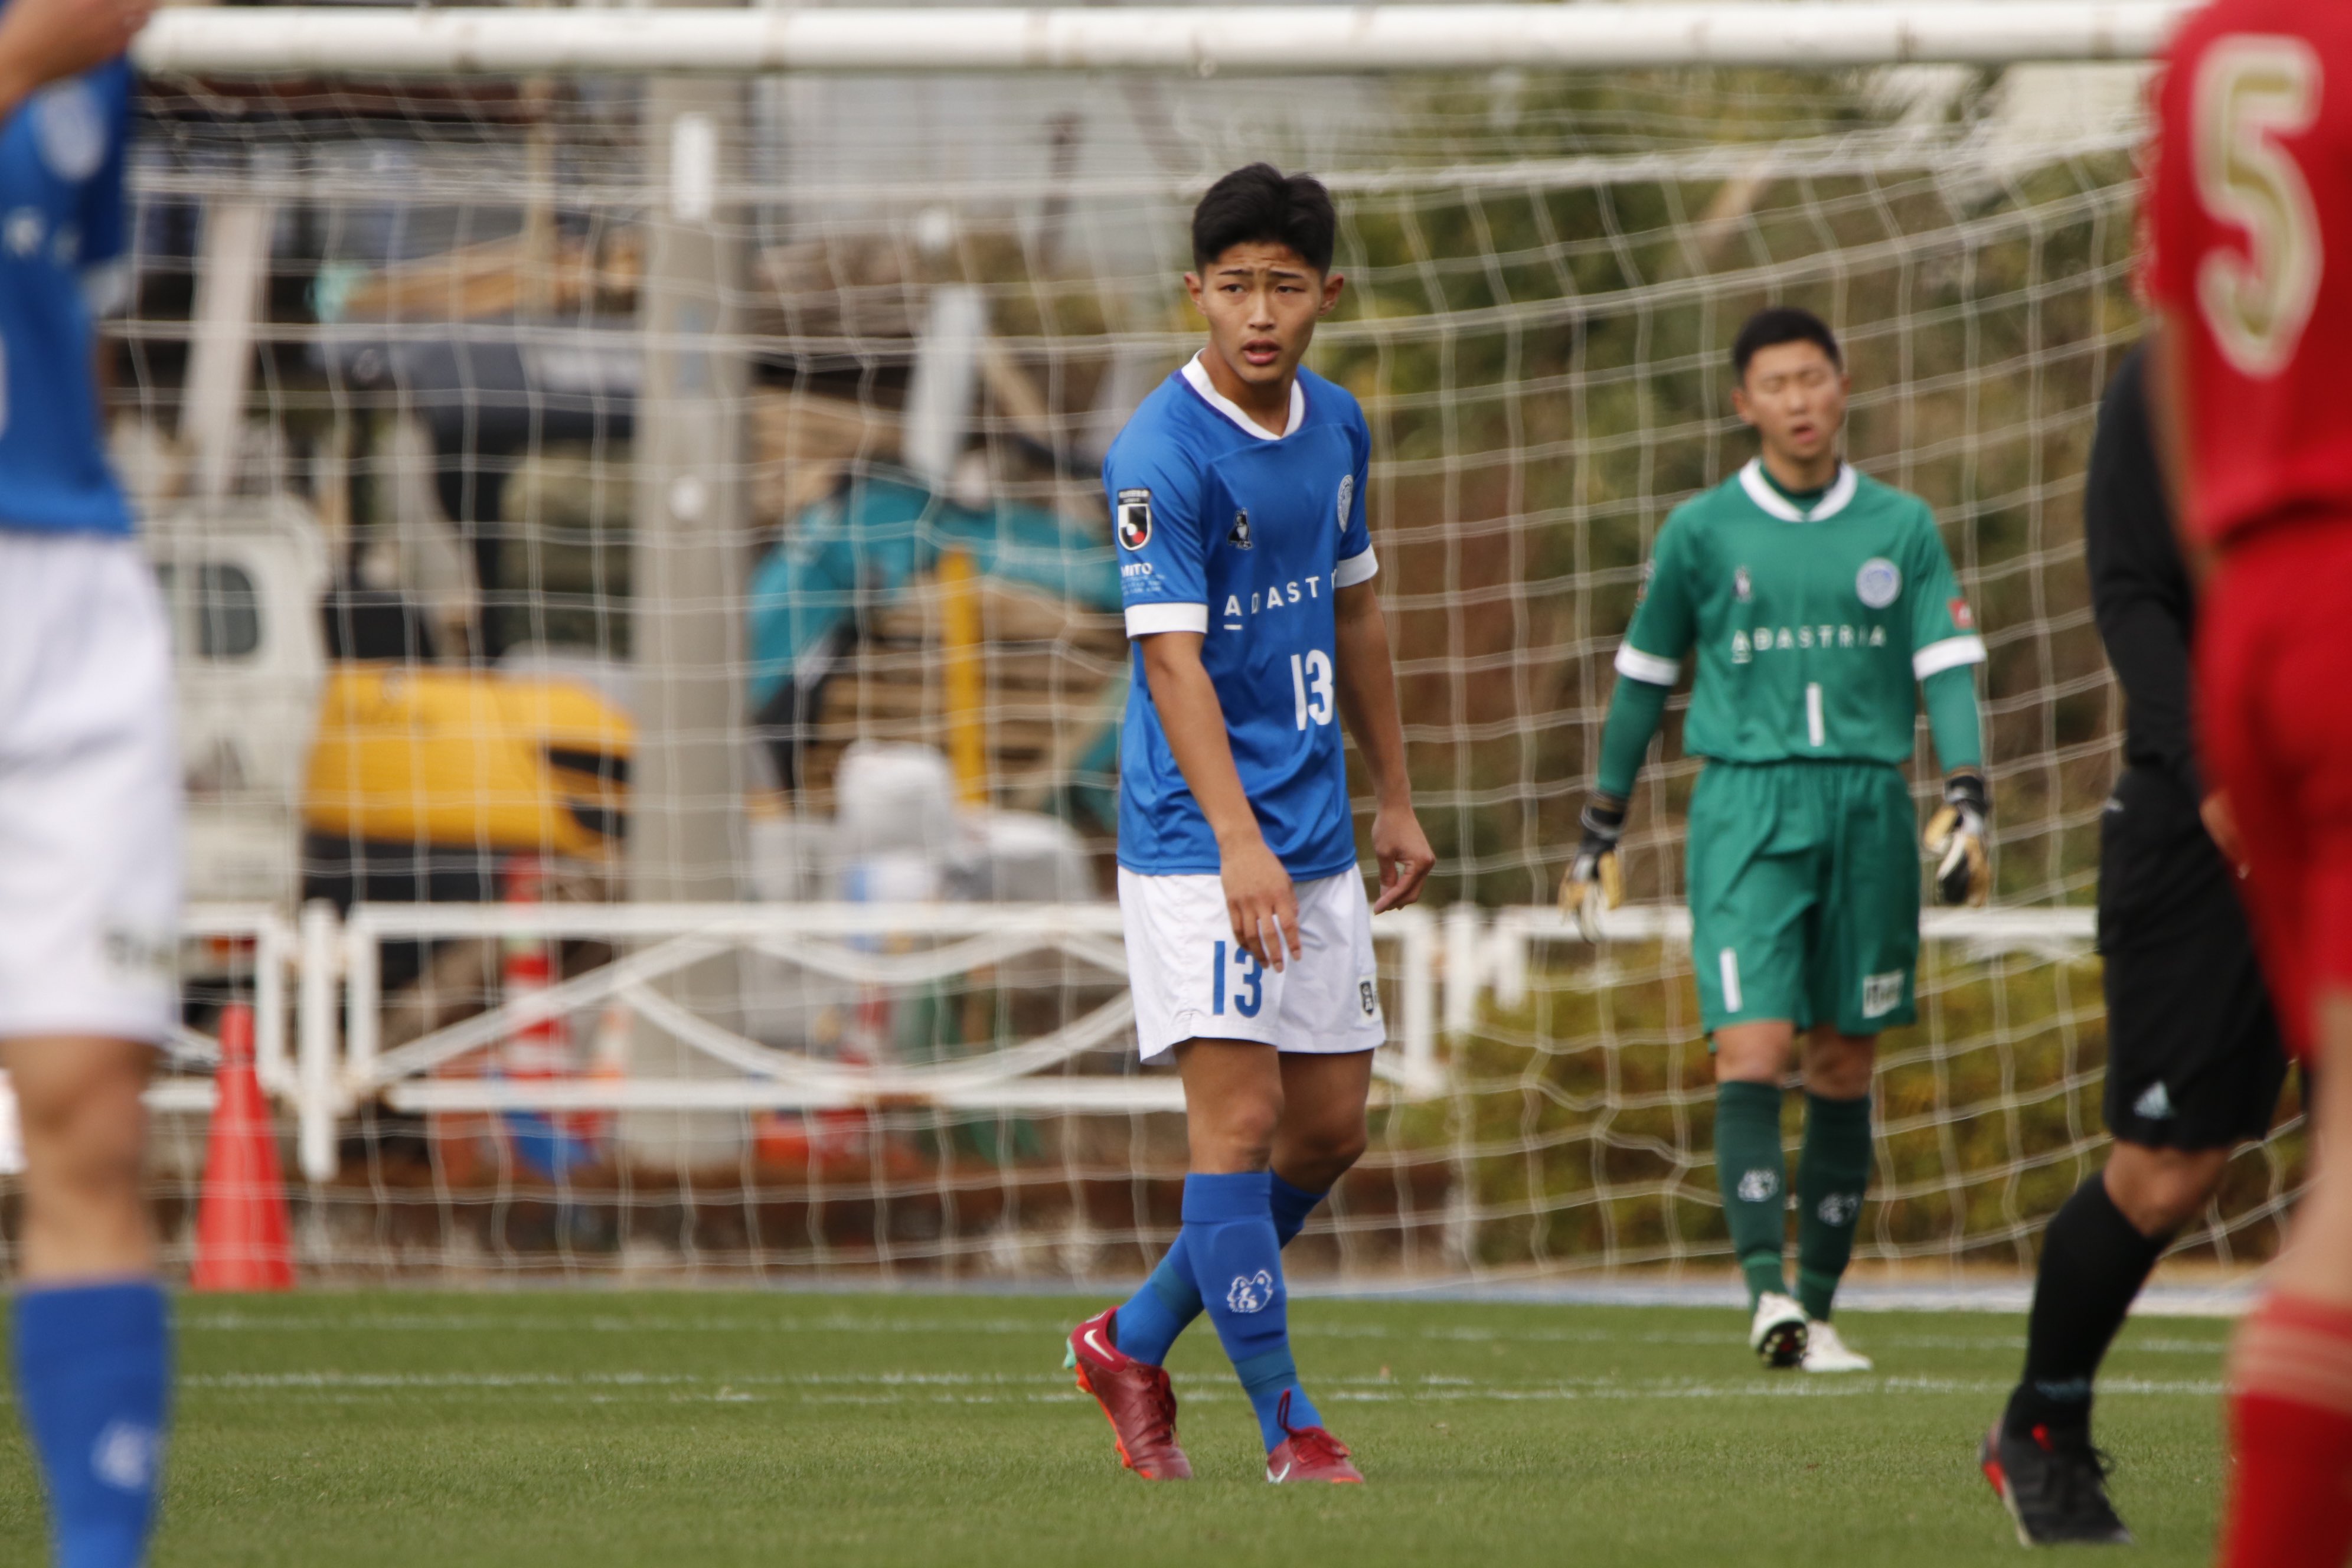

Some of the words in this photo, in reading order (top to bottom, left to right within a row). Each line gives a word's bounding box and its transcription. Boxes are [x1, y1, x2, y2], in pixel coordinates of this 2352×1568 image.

[2191, 31, 2325, 383] 5
[1732, 624, 1887, 652] ADASTRIA
[1290, 649, 1335, 731] 13
[1806, 682, 1824, 747] 1
[1213, 940, 1263, 1018] 13
[1719, 946, 1742, 1014] 1
